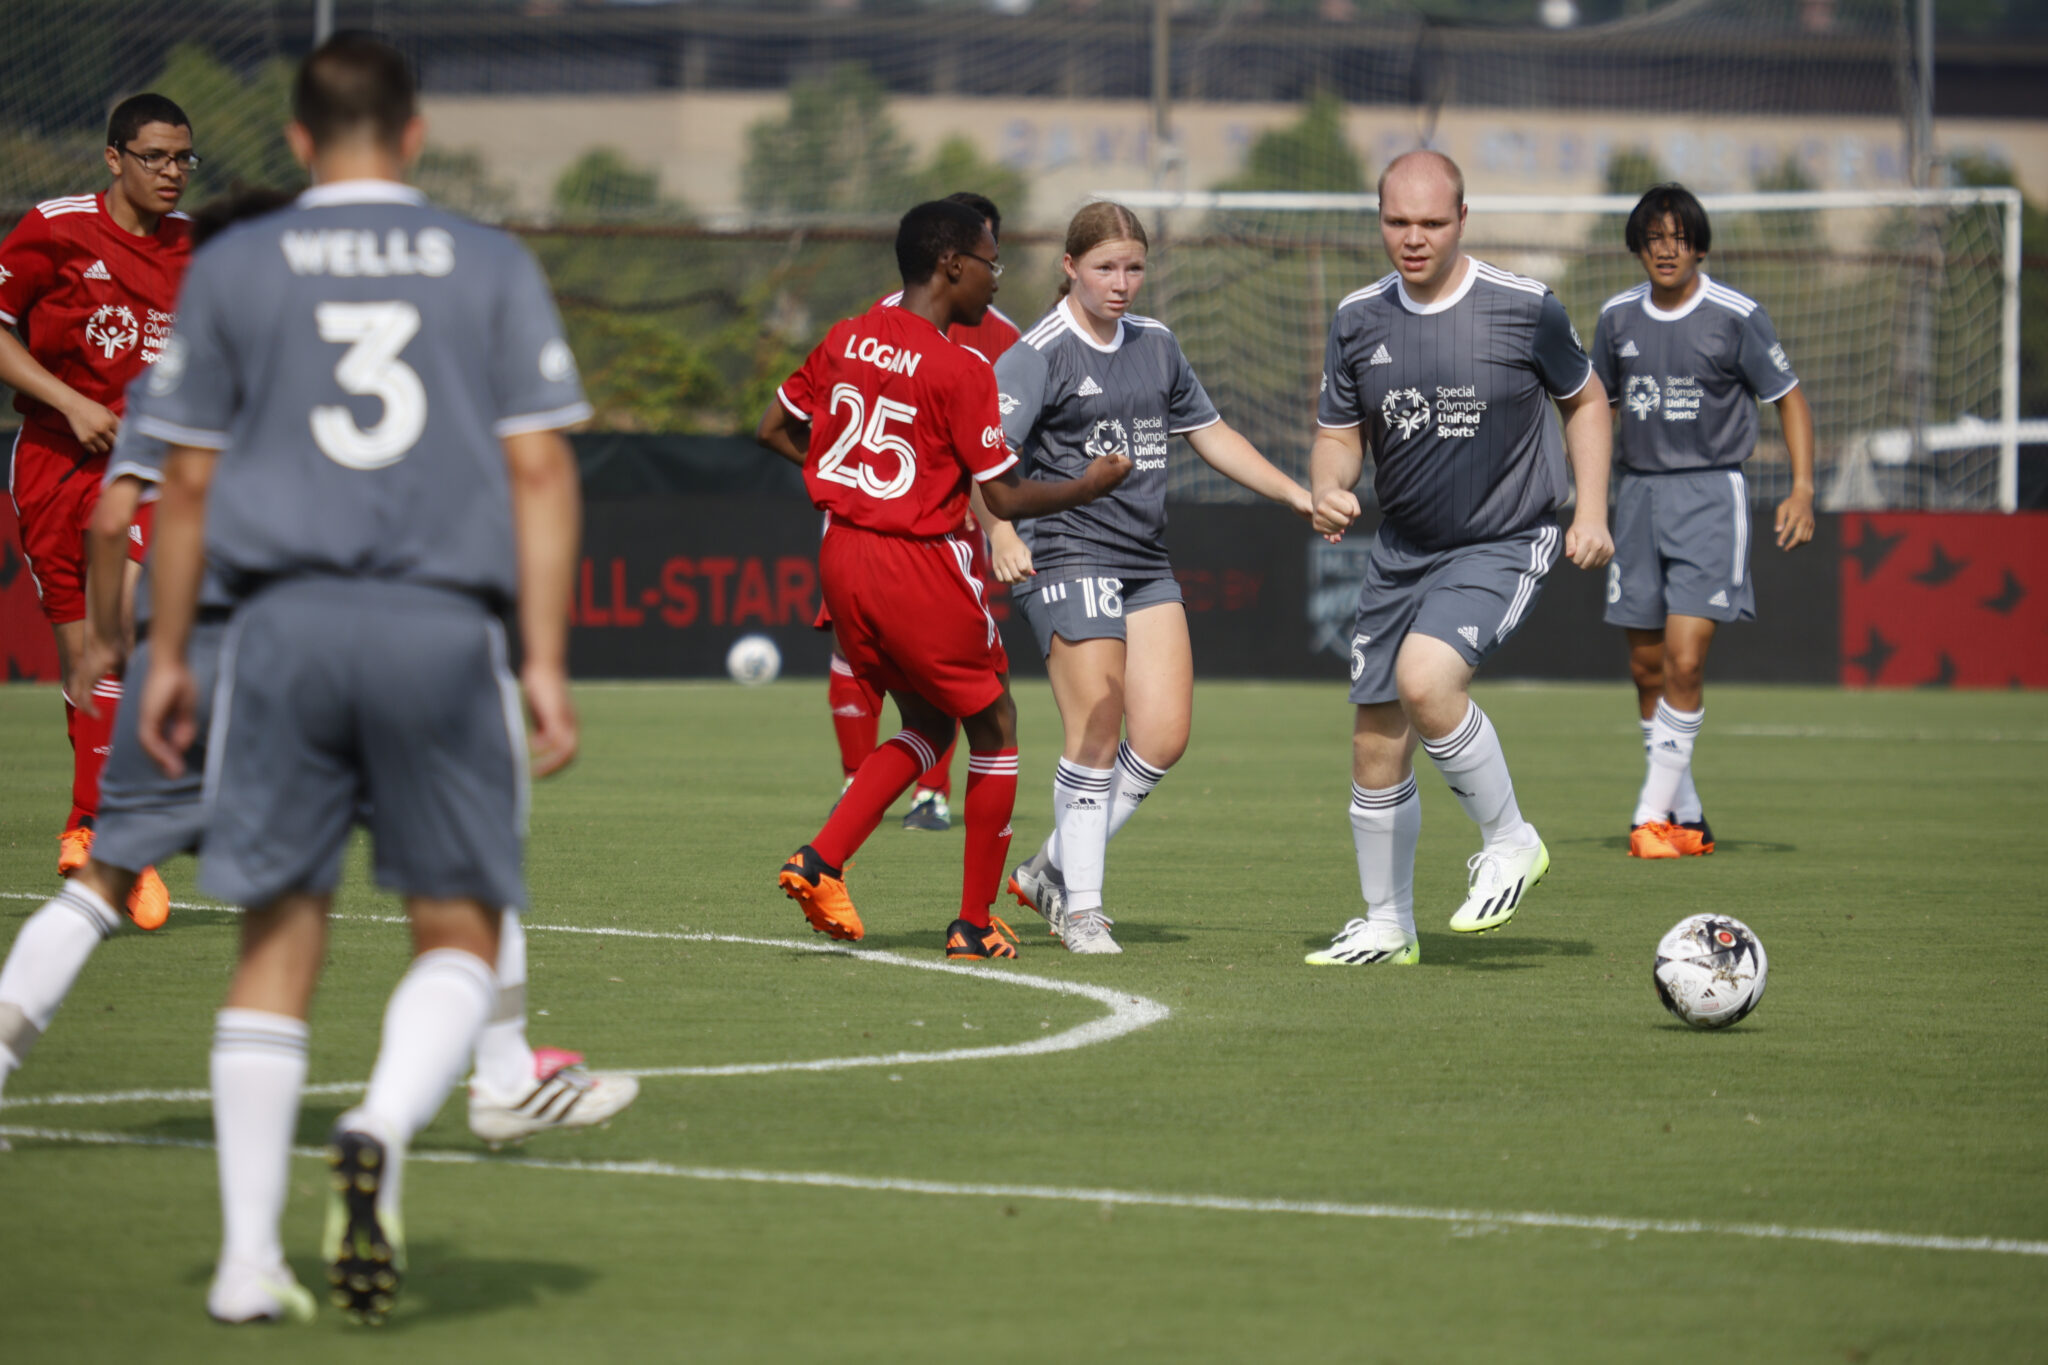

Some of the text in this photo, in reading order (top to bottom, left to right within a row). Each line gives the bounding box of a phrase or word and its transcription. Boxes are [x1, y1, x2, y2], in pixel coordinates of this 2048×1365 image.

[280, 227, 456, 278] WELLS
[844, 334, 922, 378] LOGAN
[309, 300, 428, 470] 3
[1436, 385, 1475, 399] Special
[1133, 416, 1163, 430] Special
[1436, 400, 1487, 413] Olympics
[1438, 412, 1481, 424] Unified
[816, 382, 918, 500] 25
[1132, 430, 1168, 445] Olympic
[1134, 443, 1167, 456] Unified
[568, 555, 818, 630] LL-STAR
[1075, 577, 1124, 618] 18
[1351, 633, 1371, 681] 5
